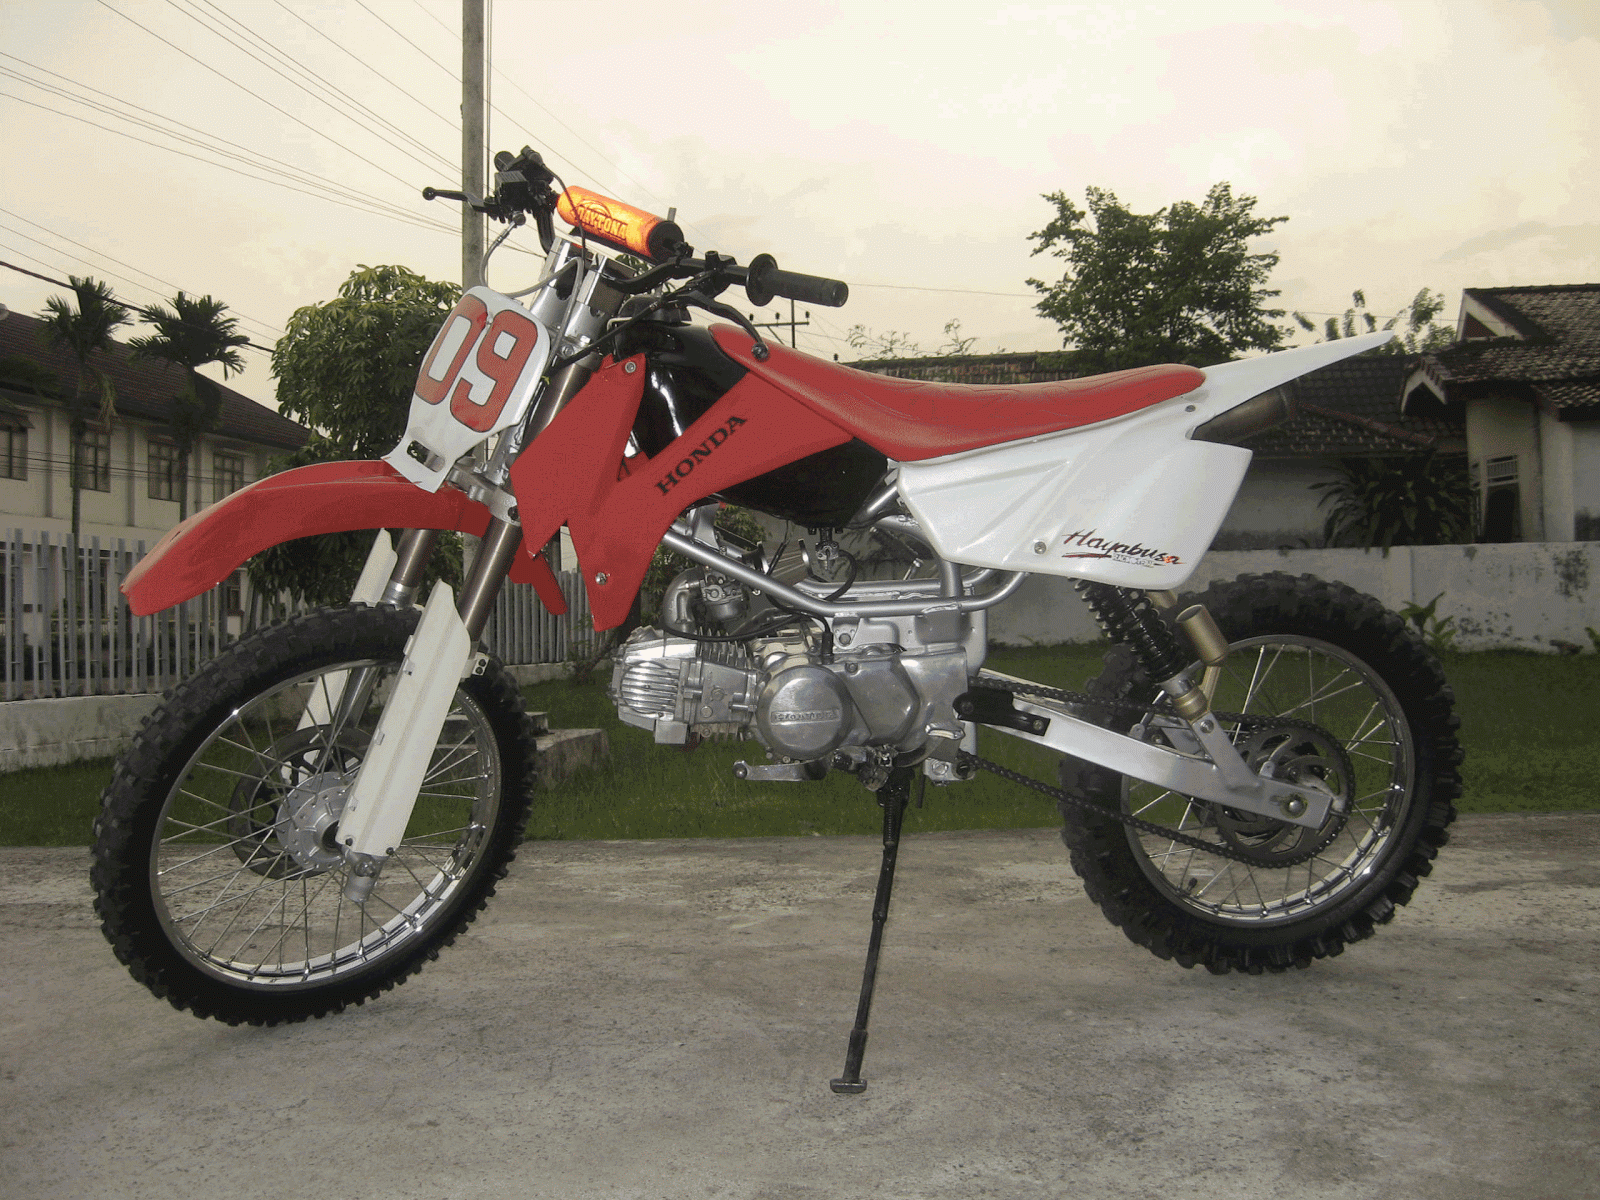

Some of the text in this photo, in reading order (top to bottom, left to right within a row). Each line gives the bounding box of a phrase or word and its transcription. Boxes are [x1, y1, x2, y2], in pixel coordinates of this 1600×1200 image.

[414, 293, 538, 433] 09
[655, 415, 747, 496] HONDA
[1061, 528, 1185, 565] Hayabusa
